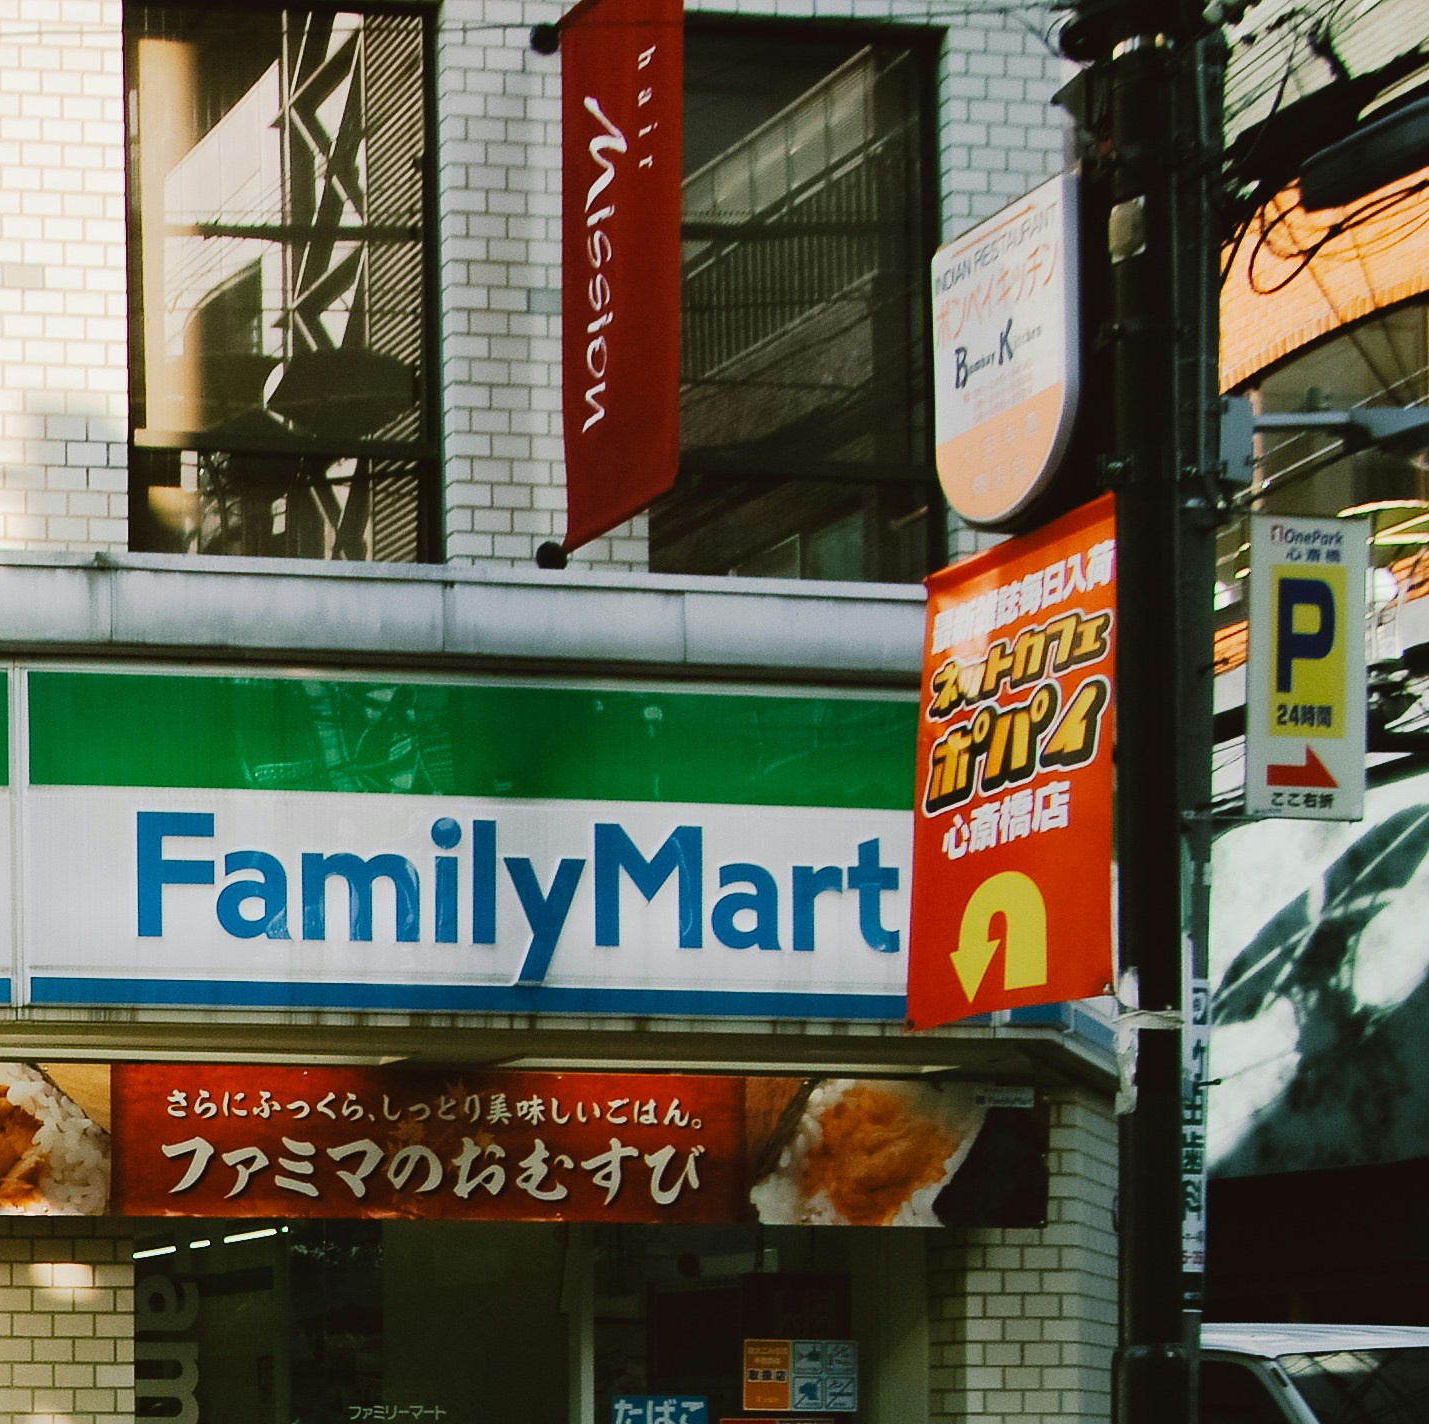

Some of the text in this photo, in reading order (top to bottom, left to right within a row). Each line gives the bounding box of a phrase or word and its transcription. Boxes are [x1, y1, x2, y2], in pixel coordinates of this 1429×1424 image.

[638, 44, 658, 169] hair
[583, 95, 628, 433] Mission
[972, 200, 1059, 274] RESTAURANT
[1284, 527, 1343, 545] OnePark
[1285, 549, 1341, 562] 心斎橋
[931, 540, 1116, 655] 最新雑誌毎日入荷
[1277, 577, 1335, 693] P
[929, 609, 1112, 722] ネットカフェ
[923, 677, 1111, 818] ポパイ
[1276, 704, 1332, 728] 24時間
[941, 780, 1071, 860] 心斎橋店
[1270, 791, 1335, 809] ここ右折
[136, 810, 901, 983] FamilyMart
[165, 1088, 704, 1131] さらにふっくら、しっとり美味しいごはん。
[160, 1135, 705, 1207] ファミマのおむすび
[348, 1404, 447, 1420] ファミリーマート
